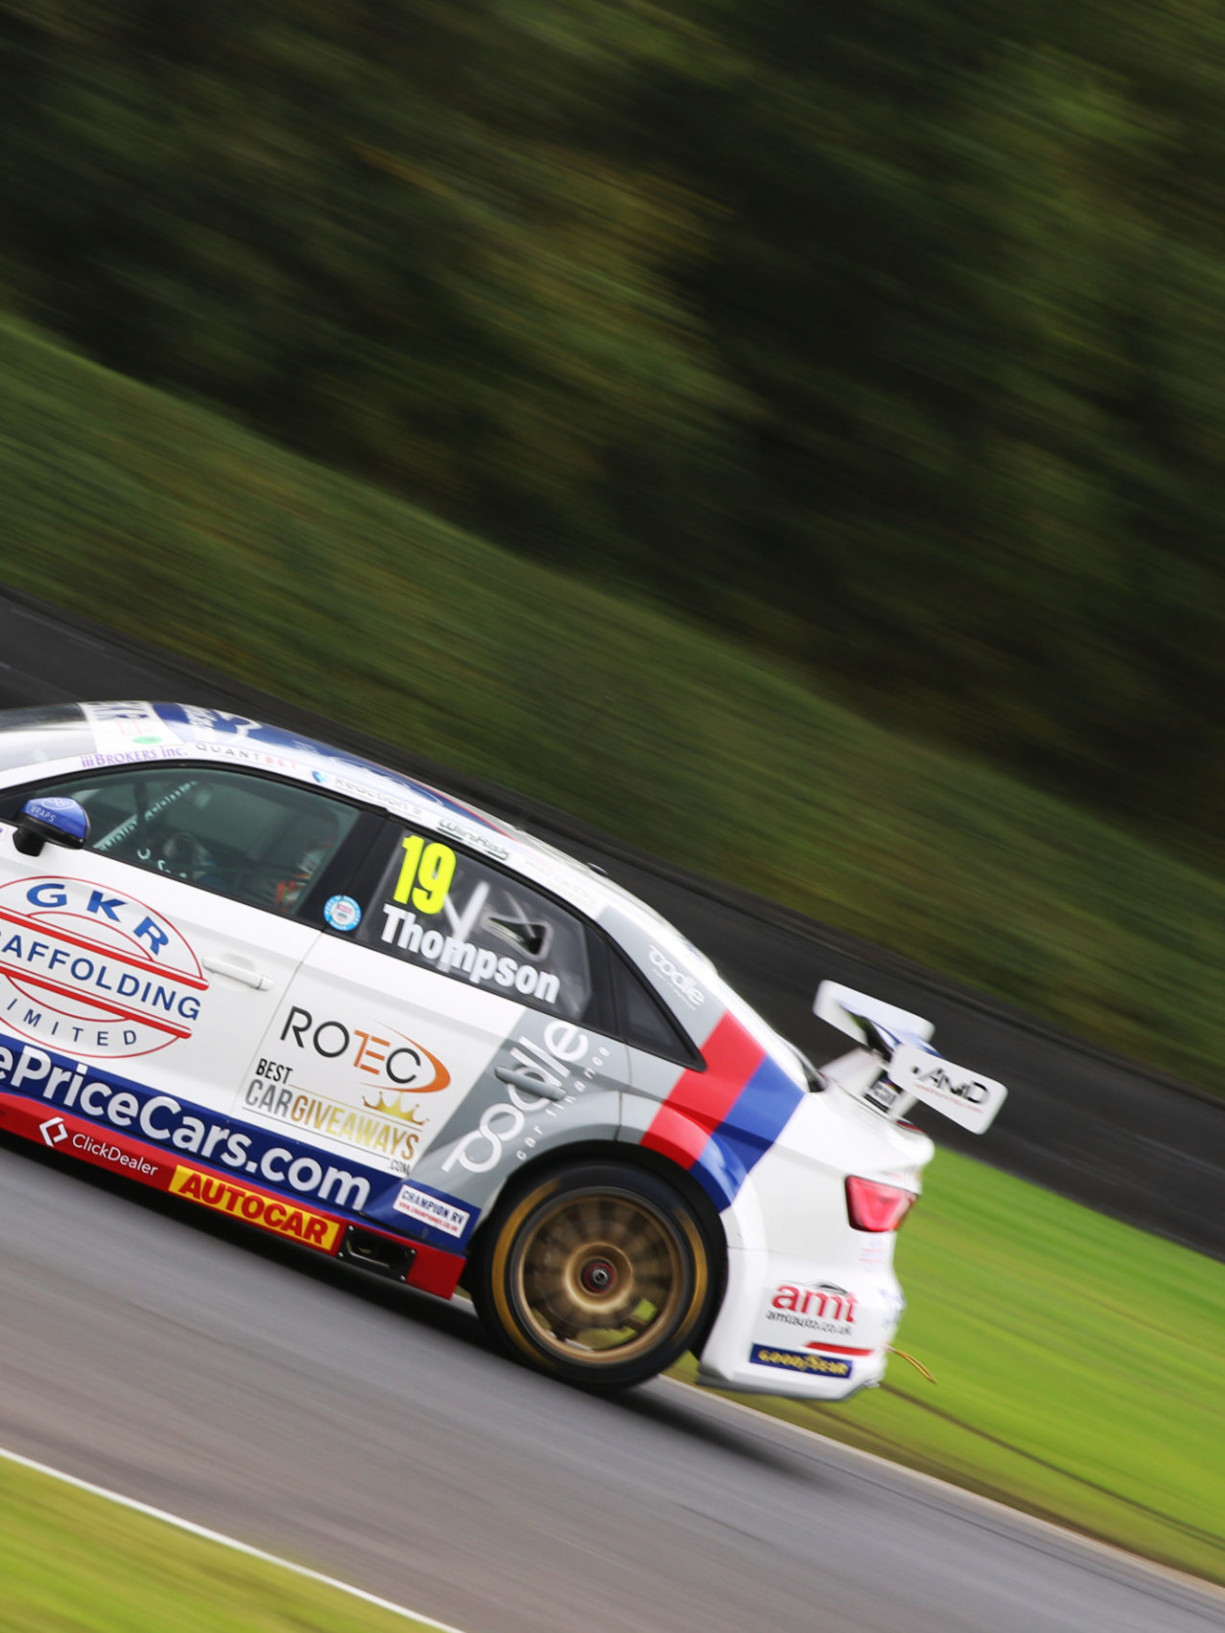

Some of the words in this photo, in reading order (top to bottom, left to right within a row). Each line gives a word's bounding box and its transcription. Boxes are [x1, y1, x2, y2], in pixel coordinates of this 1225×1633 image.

[393, 834, 457, 915] 19
[26, 883, 169, 955] GKR
[381, 903, 560, 1004] Thompson
[255, 1058, 294, 1085] BEST
[72, 1133, 159, 1176] ClickDealer
[178, 1173, 330, 1245] AUTOCAR
[402, 1190, 450, 1218] CHAMPION
[450, 1211, 464, 1225] RV
